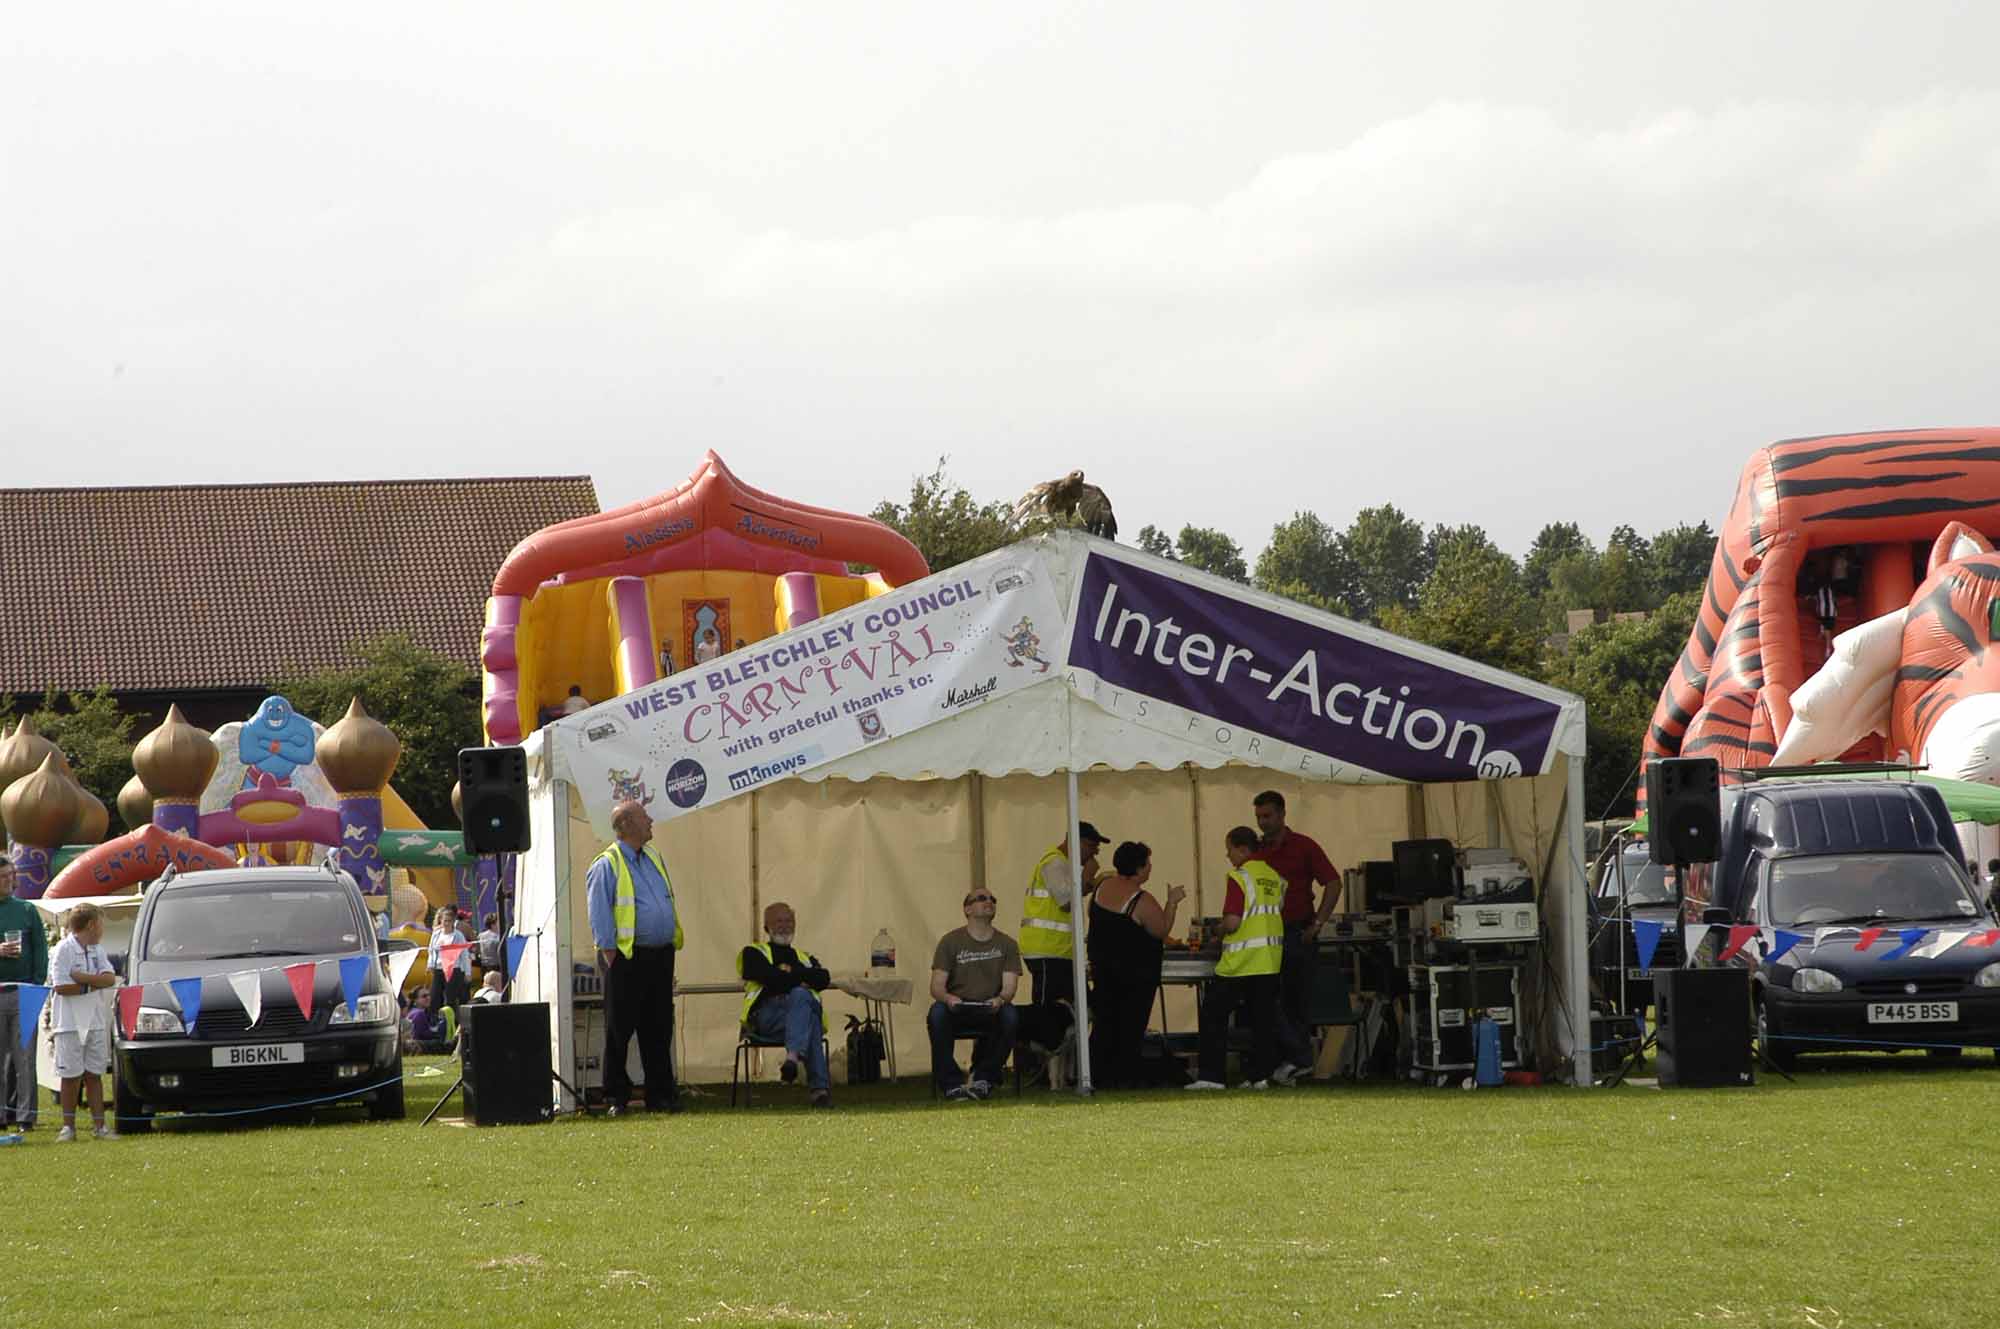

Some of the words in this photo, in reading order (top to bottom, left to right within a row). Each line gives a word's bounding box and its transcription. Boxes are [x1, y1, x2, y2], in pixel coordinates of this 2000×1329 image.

[624, 679, 697, 721] WEST
[706, 619, 856, 693] BLETCHLEY
[864, 578, 982, 634] COUNCIL
[1093, 582, 1487, 768] Inter-Action
[683, 623, 955, 745] CARNIVAL
[723, 735, 764, 758] with
[768, 705, 839, 745] grateful
[843, 684, 905, 715] thanks
[908, 672, 934, 691] to:
[941, 676, 997, 709] Marshall
[1187, 716, 1261, 755] FOR
[667, 773, 706, 794] HORIZON
[1874, 1005, 1916, 1020] P445
[1921, 1004, 1950, 1019] BSS
